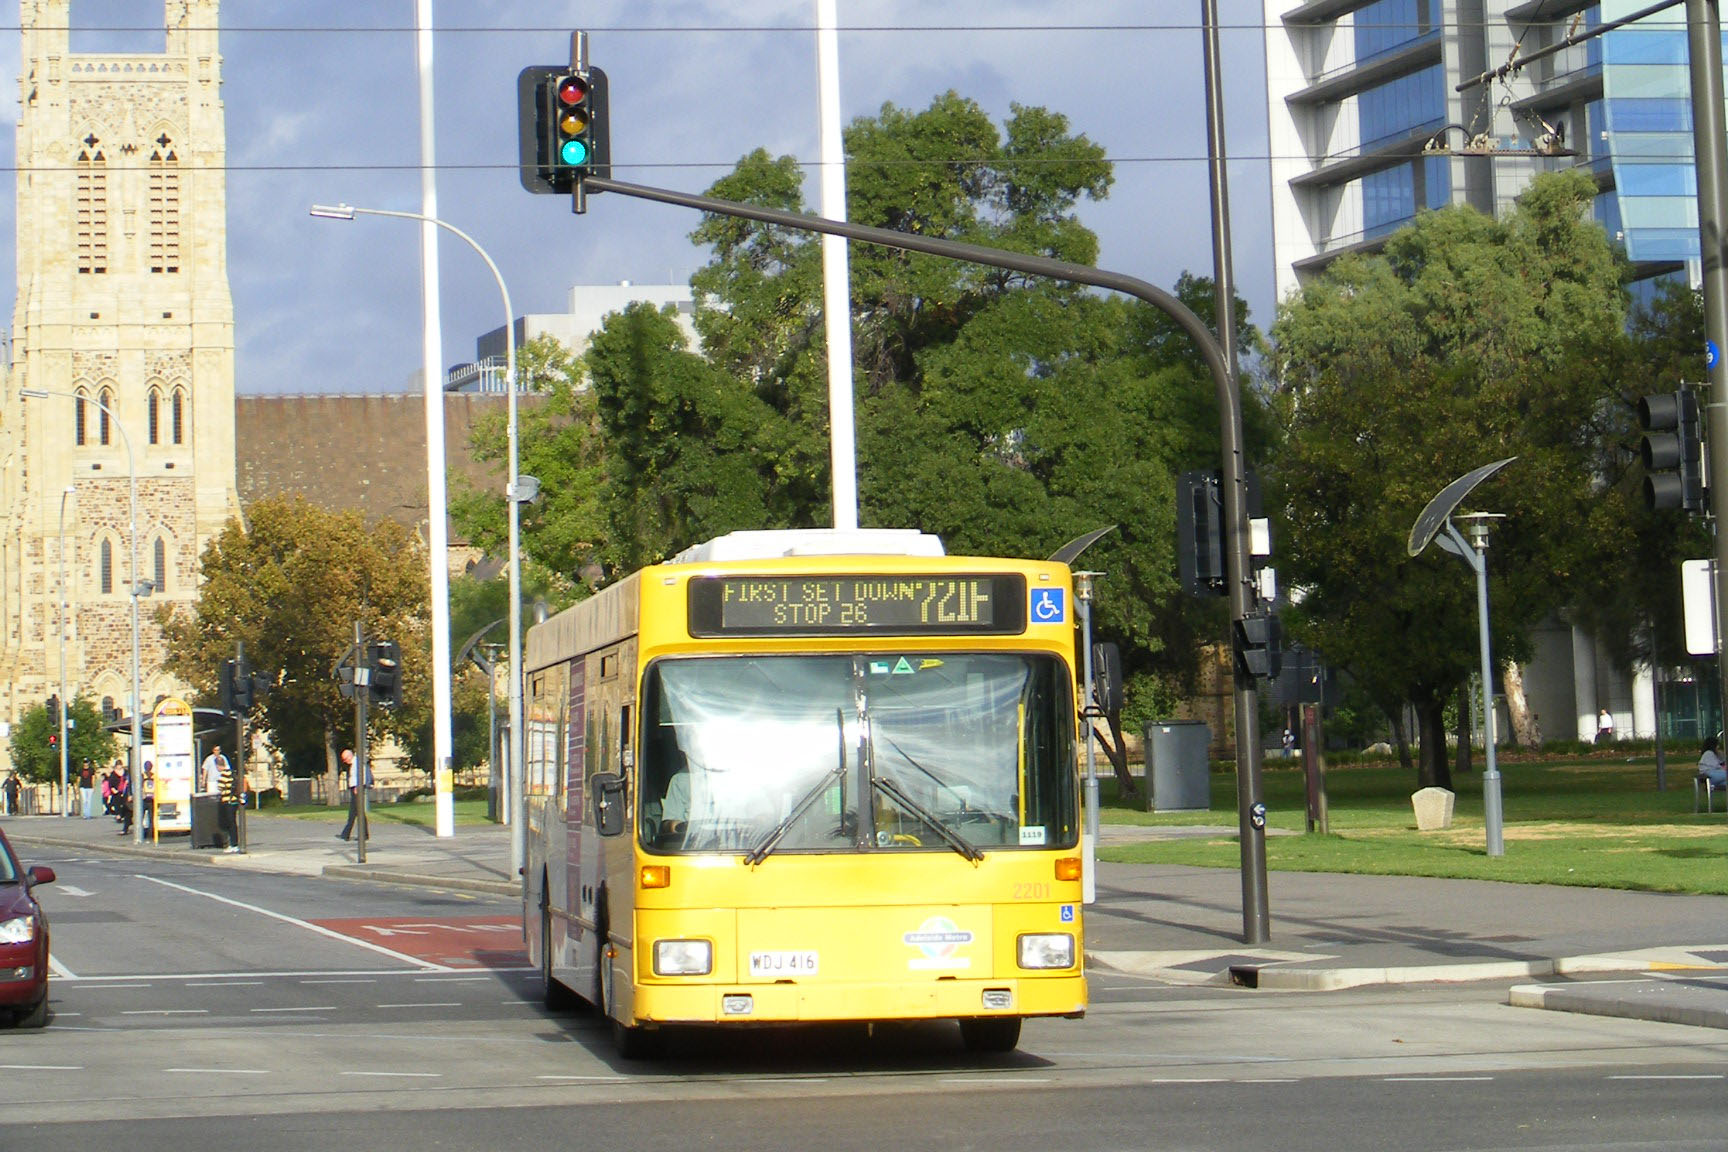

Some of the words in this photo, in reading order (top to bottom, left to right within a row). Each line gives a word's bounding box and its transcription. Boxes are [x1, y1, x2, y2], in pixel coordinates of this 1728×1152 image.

[802, 580, 843, 602] SET
[773, 603, 831, 624] STOP
[840, 603, 868, 623] 26
[1013, 882, 1050, 899] 2201
[752, 954, 783, 969] WDJ
[789, 954, 814, 969] 416
